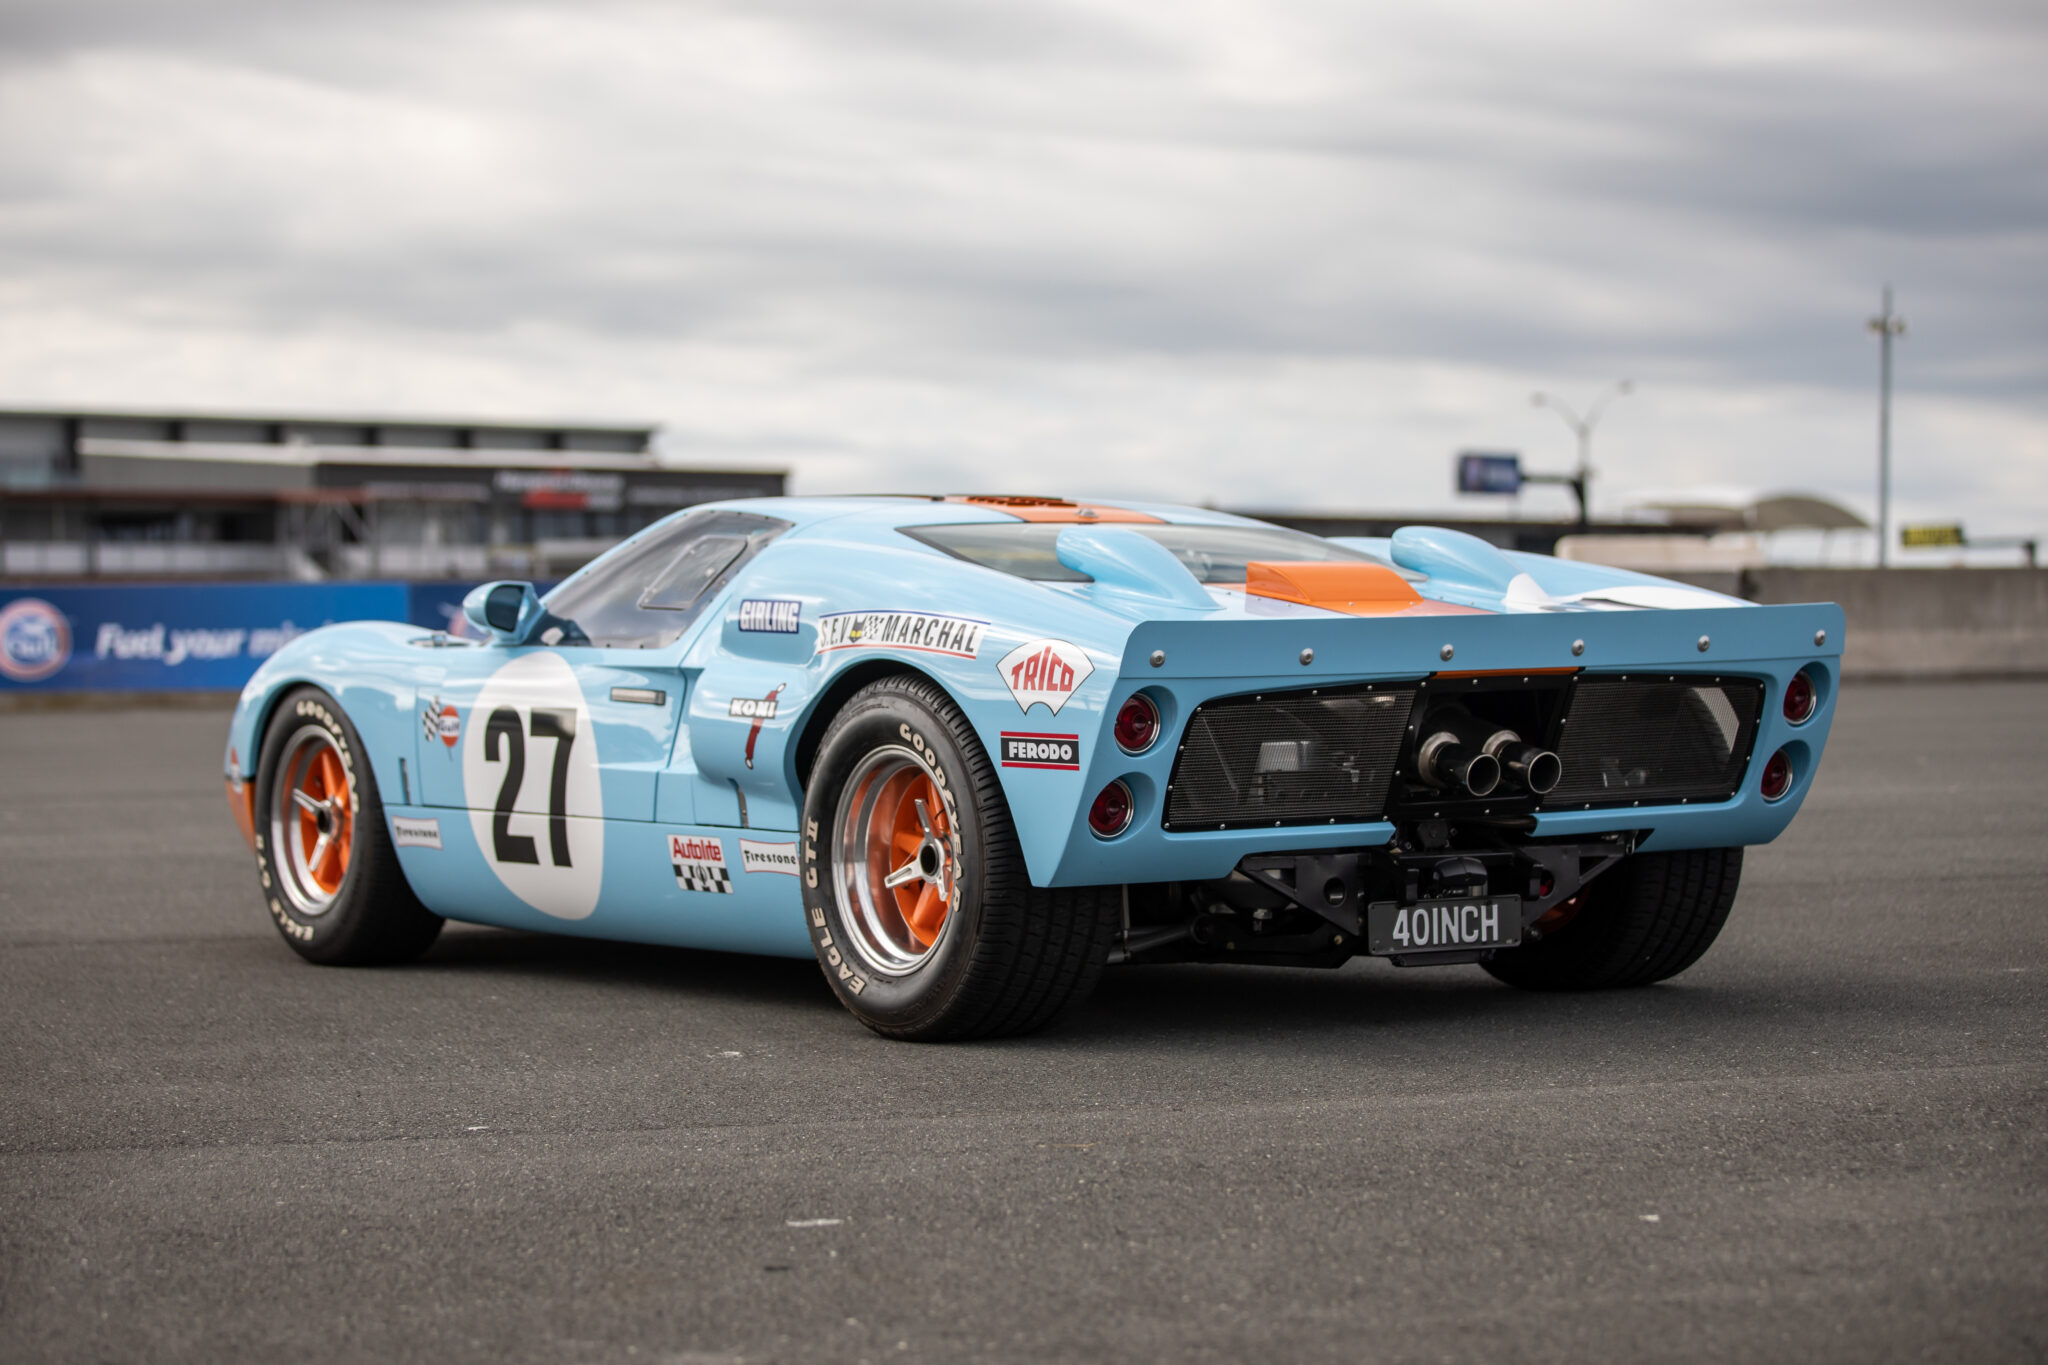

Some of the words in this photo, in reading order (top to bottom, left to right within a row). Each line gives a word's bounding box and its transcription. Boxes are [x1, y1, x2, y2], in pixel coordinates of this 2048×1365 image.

[739, 601, 800, 632] GIRLING
[881, 614, 978, 653] MARCHAL
[96, 622, 165, 660] Fuel
[162, 627, 246, 666] your
[1011, 646, 1075, 692] TRICO
[730, 699, 776, 718] KONI
[297, 701, 360, 813] GOODYEAR
[1008, 741, 1072, 761] FERODO
[484, 704, 578, 868] 27
[899, 723, 963, 913] GOODYEAR
[673, 837, 722, 862] Autolite
[743, 850, 797, 865] Firestone
[1392, 904, 1499, 947] 40INCH
[811, 906, 867, 996] EAGLE
